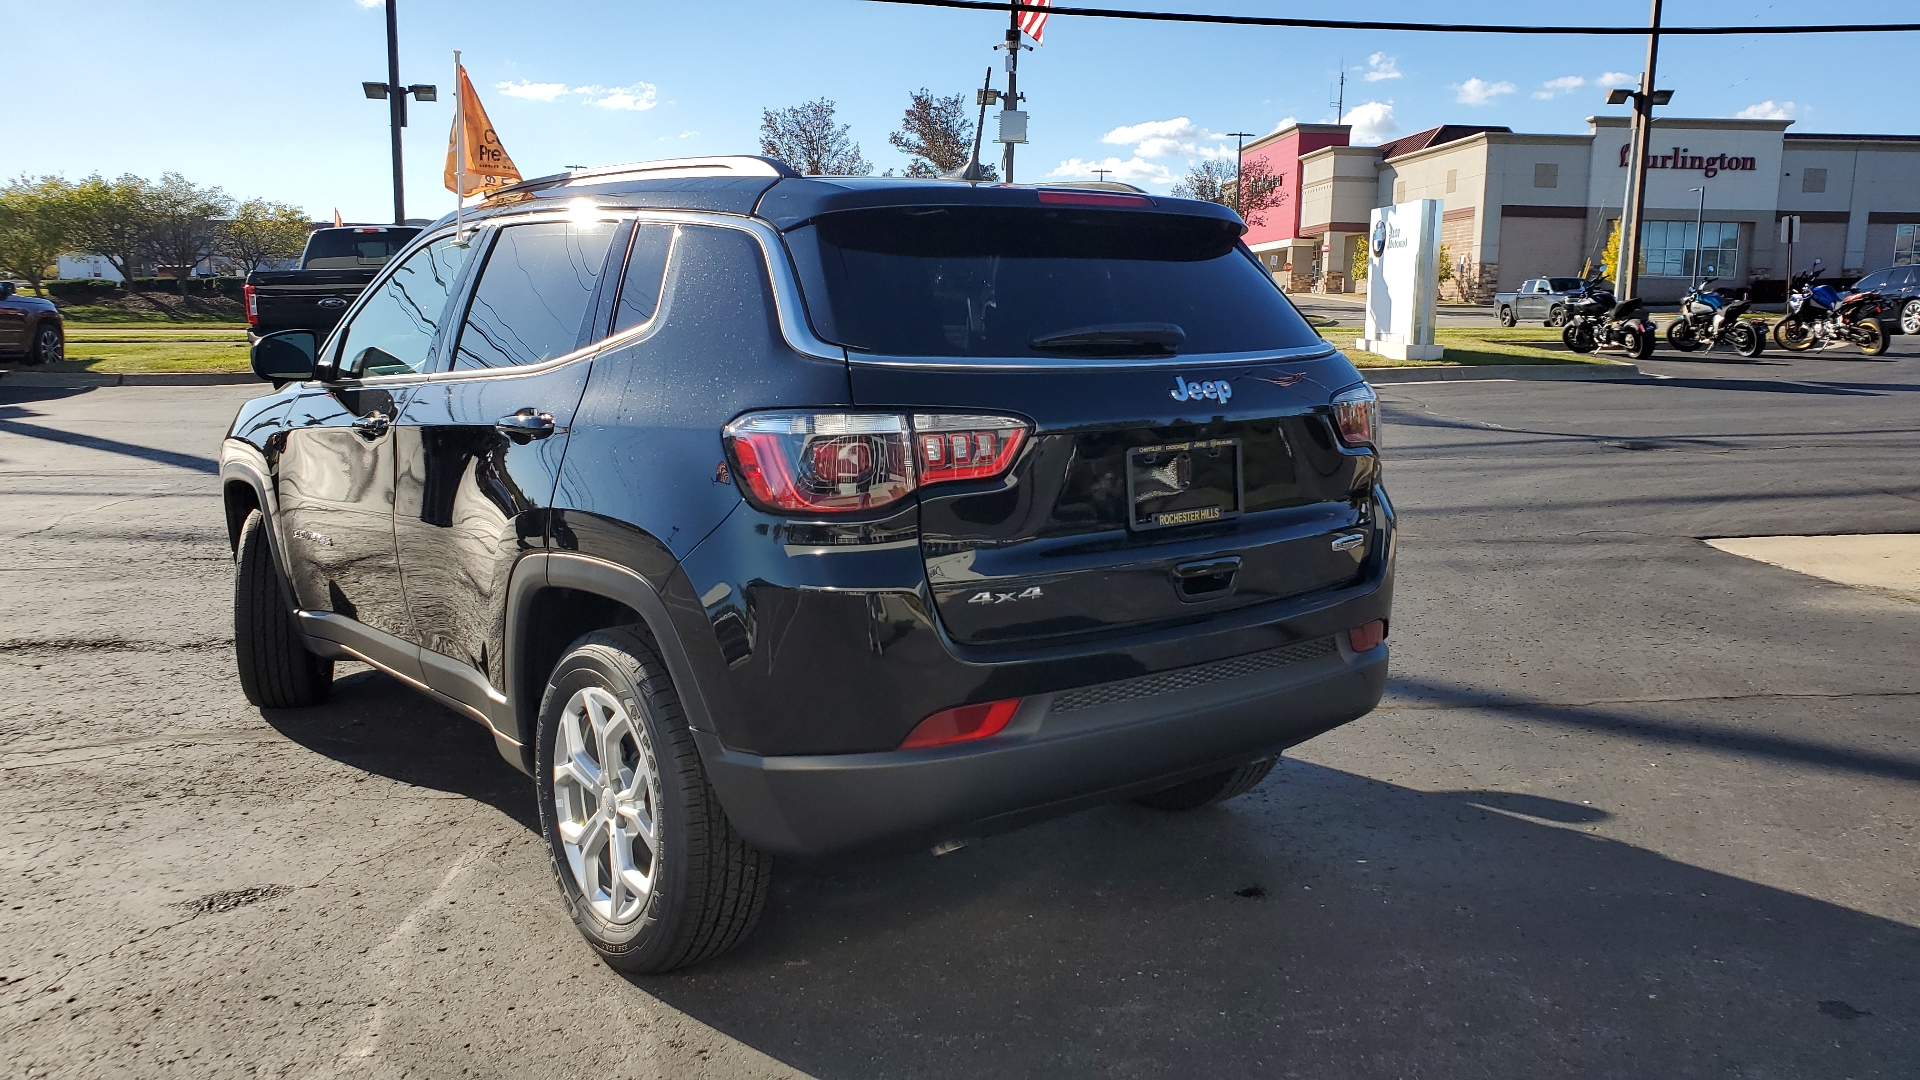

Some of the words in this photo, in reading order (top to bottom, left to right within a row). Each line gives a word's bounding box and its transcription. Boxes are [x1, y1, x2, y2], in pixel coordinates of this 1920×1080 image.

[1170, 375, 1232, 405] Jeep
[1159, 510, 1200, 526] ROCHESTER
[1200, 507, 1220, 520] HILLS
